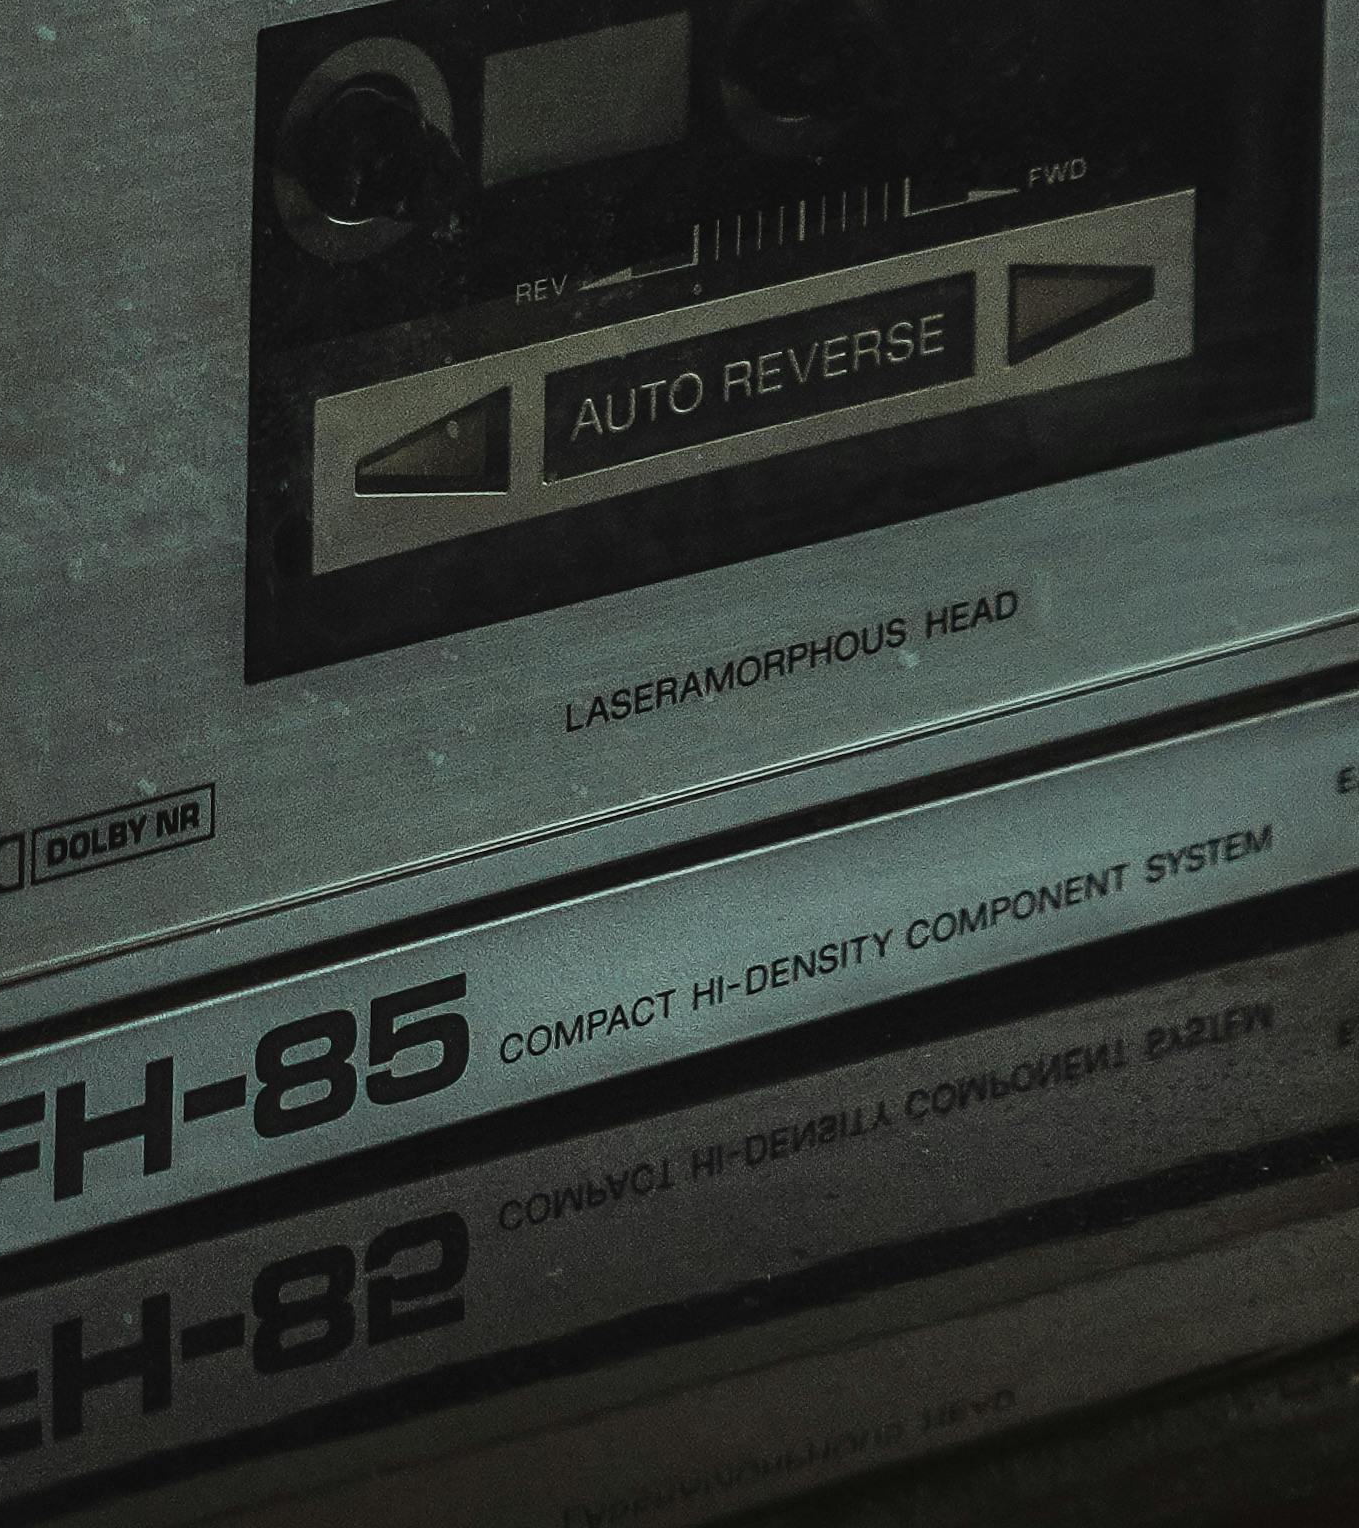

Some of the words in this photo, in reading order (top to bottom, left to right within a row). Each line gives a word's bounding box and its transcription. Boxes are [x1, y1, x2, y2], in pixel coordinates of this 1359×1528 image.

[1028, 157, 1087, 191] FWD
[515, 274, 568, 305] REV
[570, 371, 705, 443] AUTO
[723, 311, 947, 401] REVERSE
[565, 616, 908, 735] LASERAMORPHOUS
[925, 589, 1020, 639] HEAD
[46, 814, 148, 867] DOLBY
[155, 801, 201, 836] NR
[499, 989, 676, 1065] COMPACT
[693, 930, 893, 1011] HI-DENSITY
[906, 864, 1128, 951] COMPONENT
[1145, 824, 1274, 884] SYSTEM
